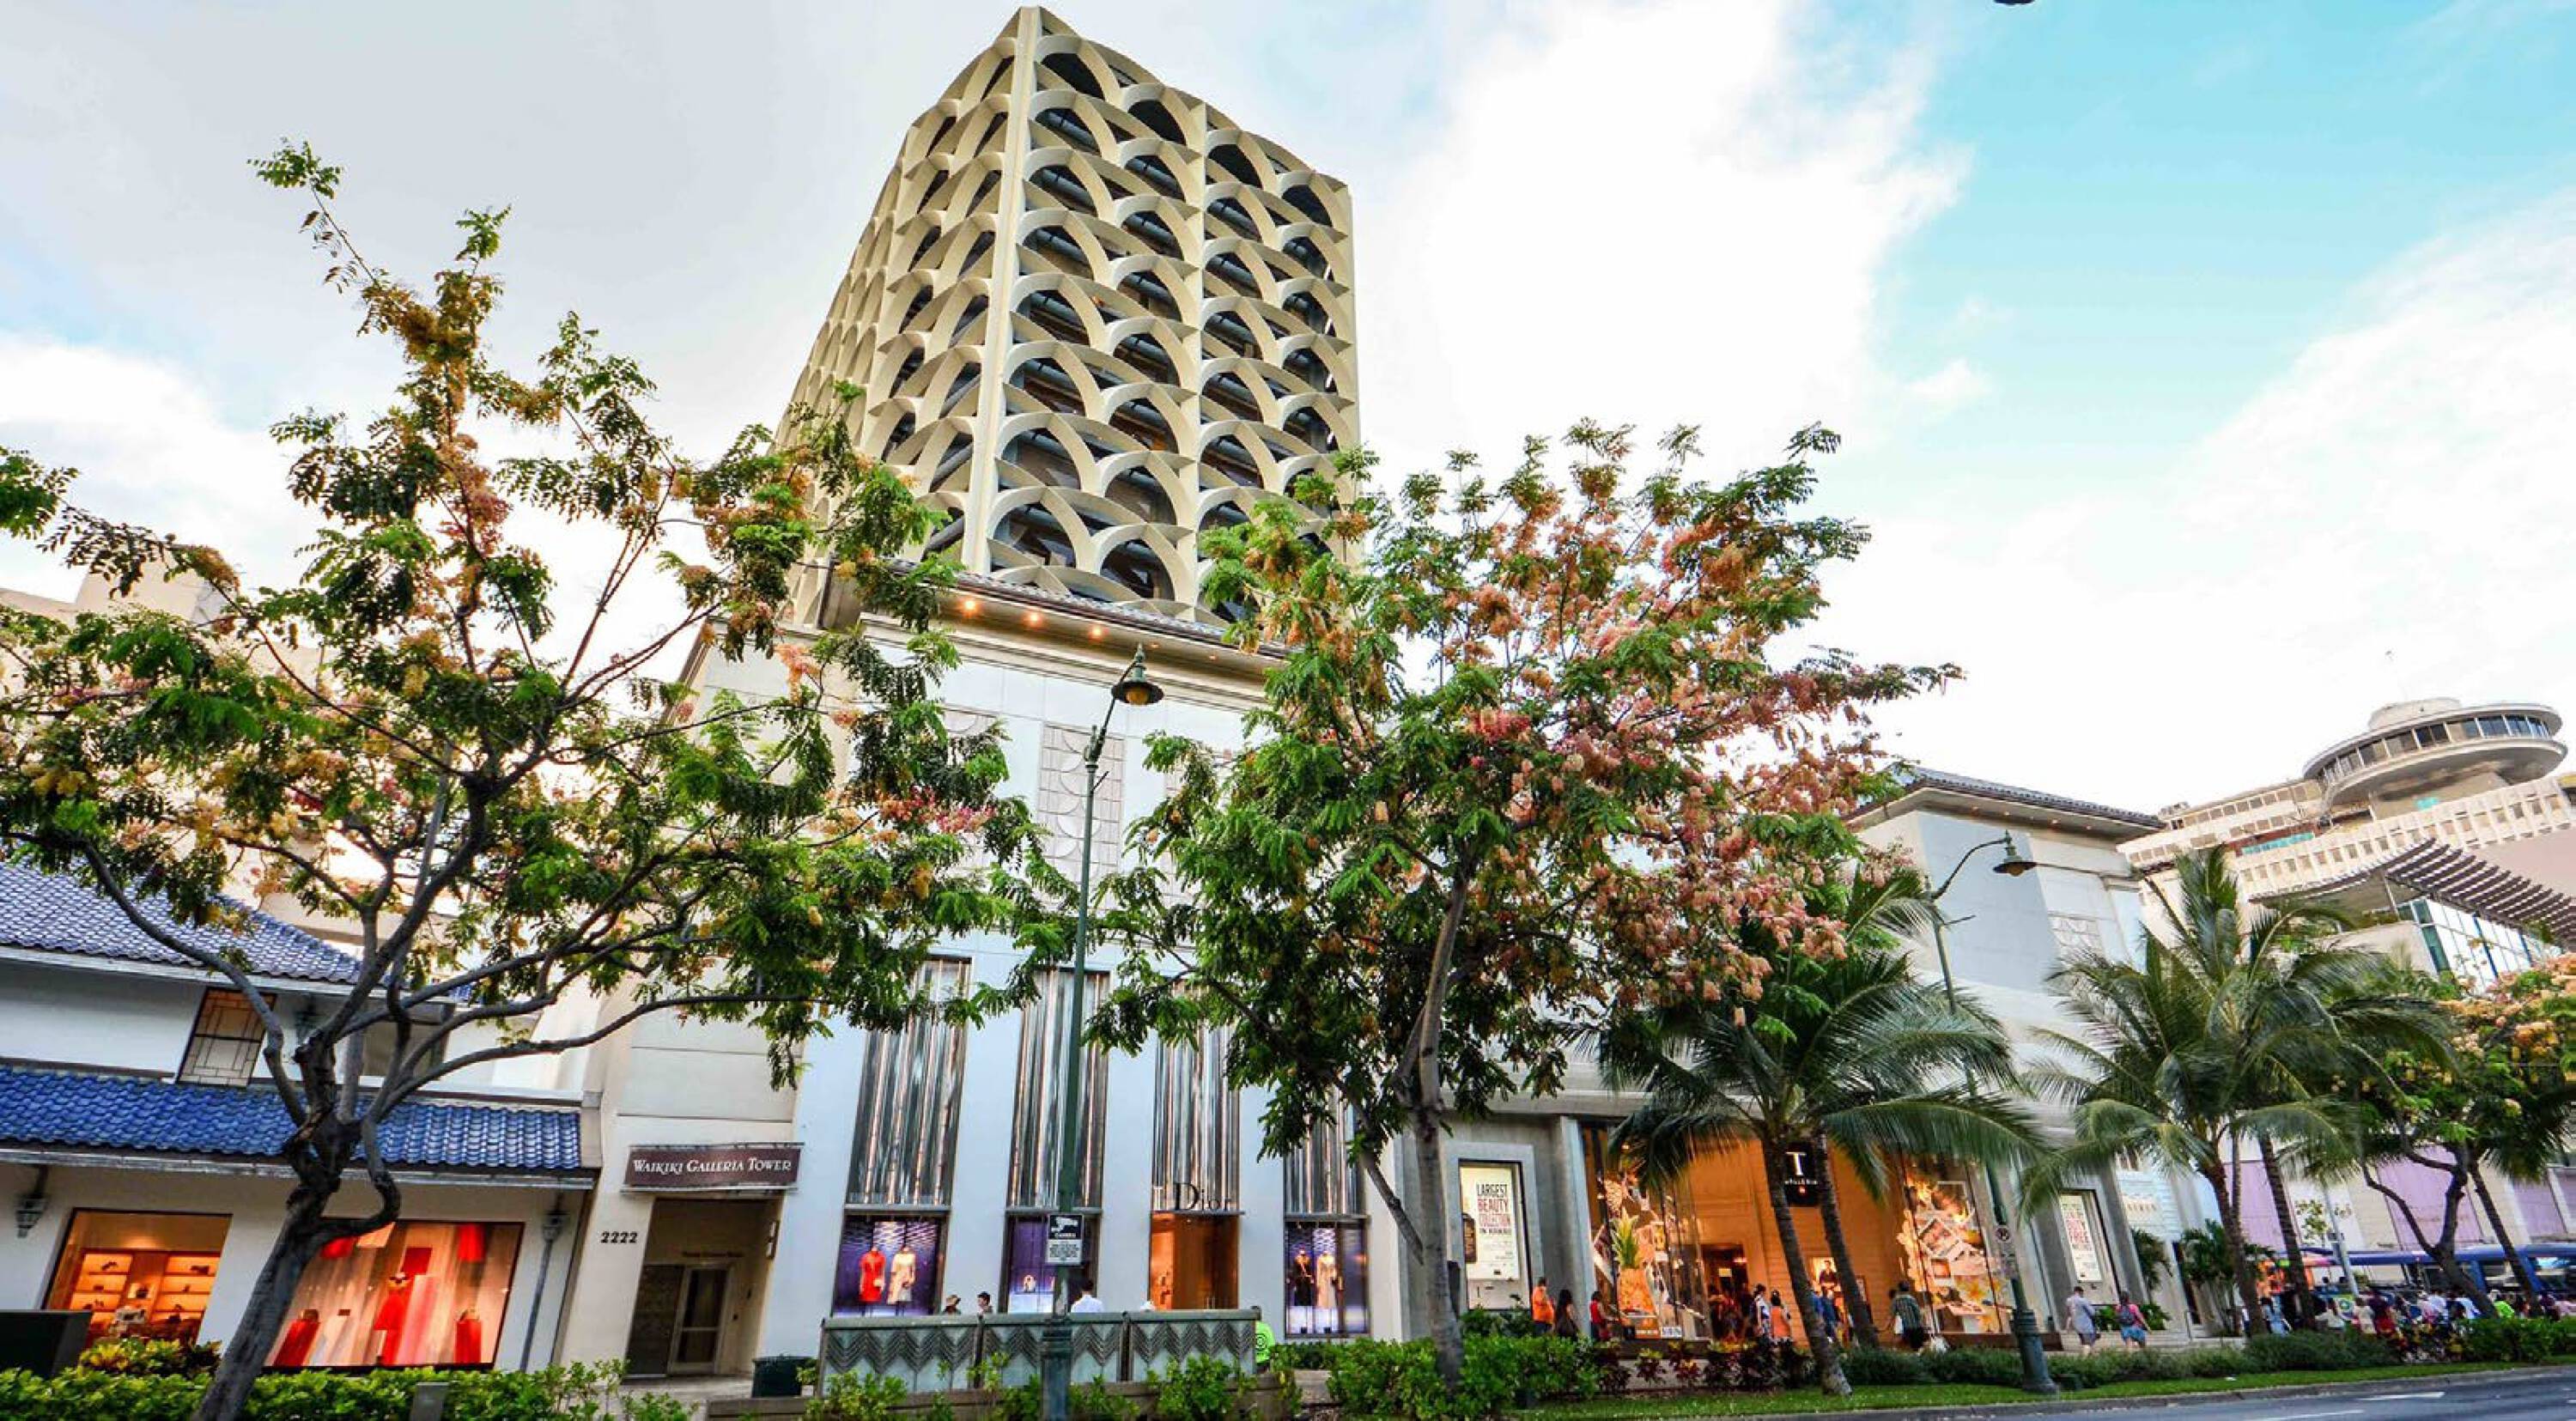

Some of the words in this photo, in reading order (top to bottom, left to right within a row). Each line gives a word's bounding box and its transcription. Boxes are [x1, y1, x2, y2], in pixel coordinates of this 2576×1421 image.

[633, 1159, 683, 1175] WAIKIKI
[687, 1159, 744, 1173] GALLERIA
[748, 1157, 792, 1172] TOWER
[1785, 1152, 1807, 1175] T
[1173, 1182, 1232, 1211] Dior
[1477, 1183, 1508, 1197] LARGEST
[1478, 1199, 1509, 1212] BEAUTY
[601, 1231, 638, 1244] 2222
